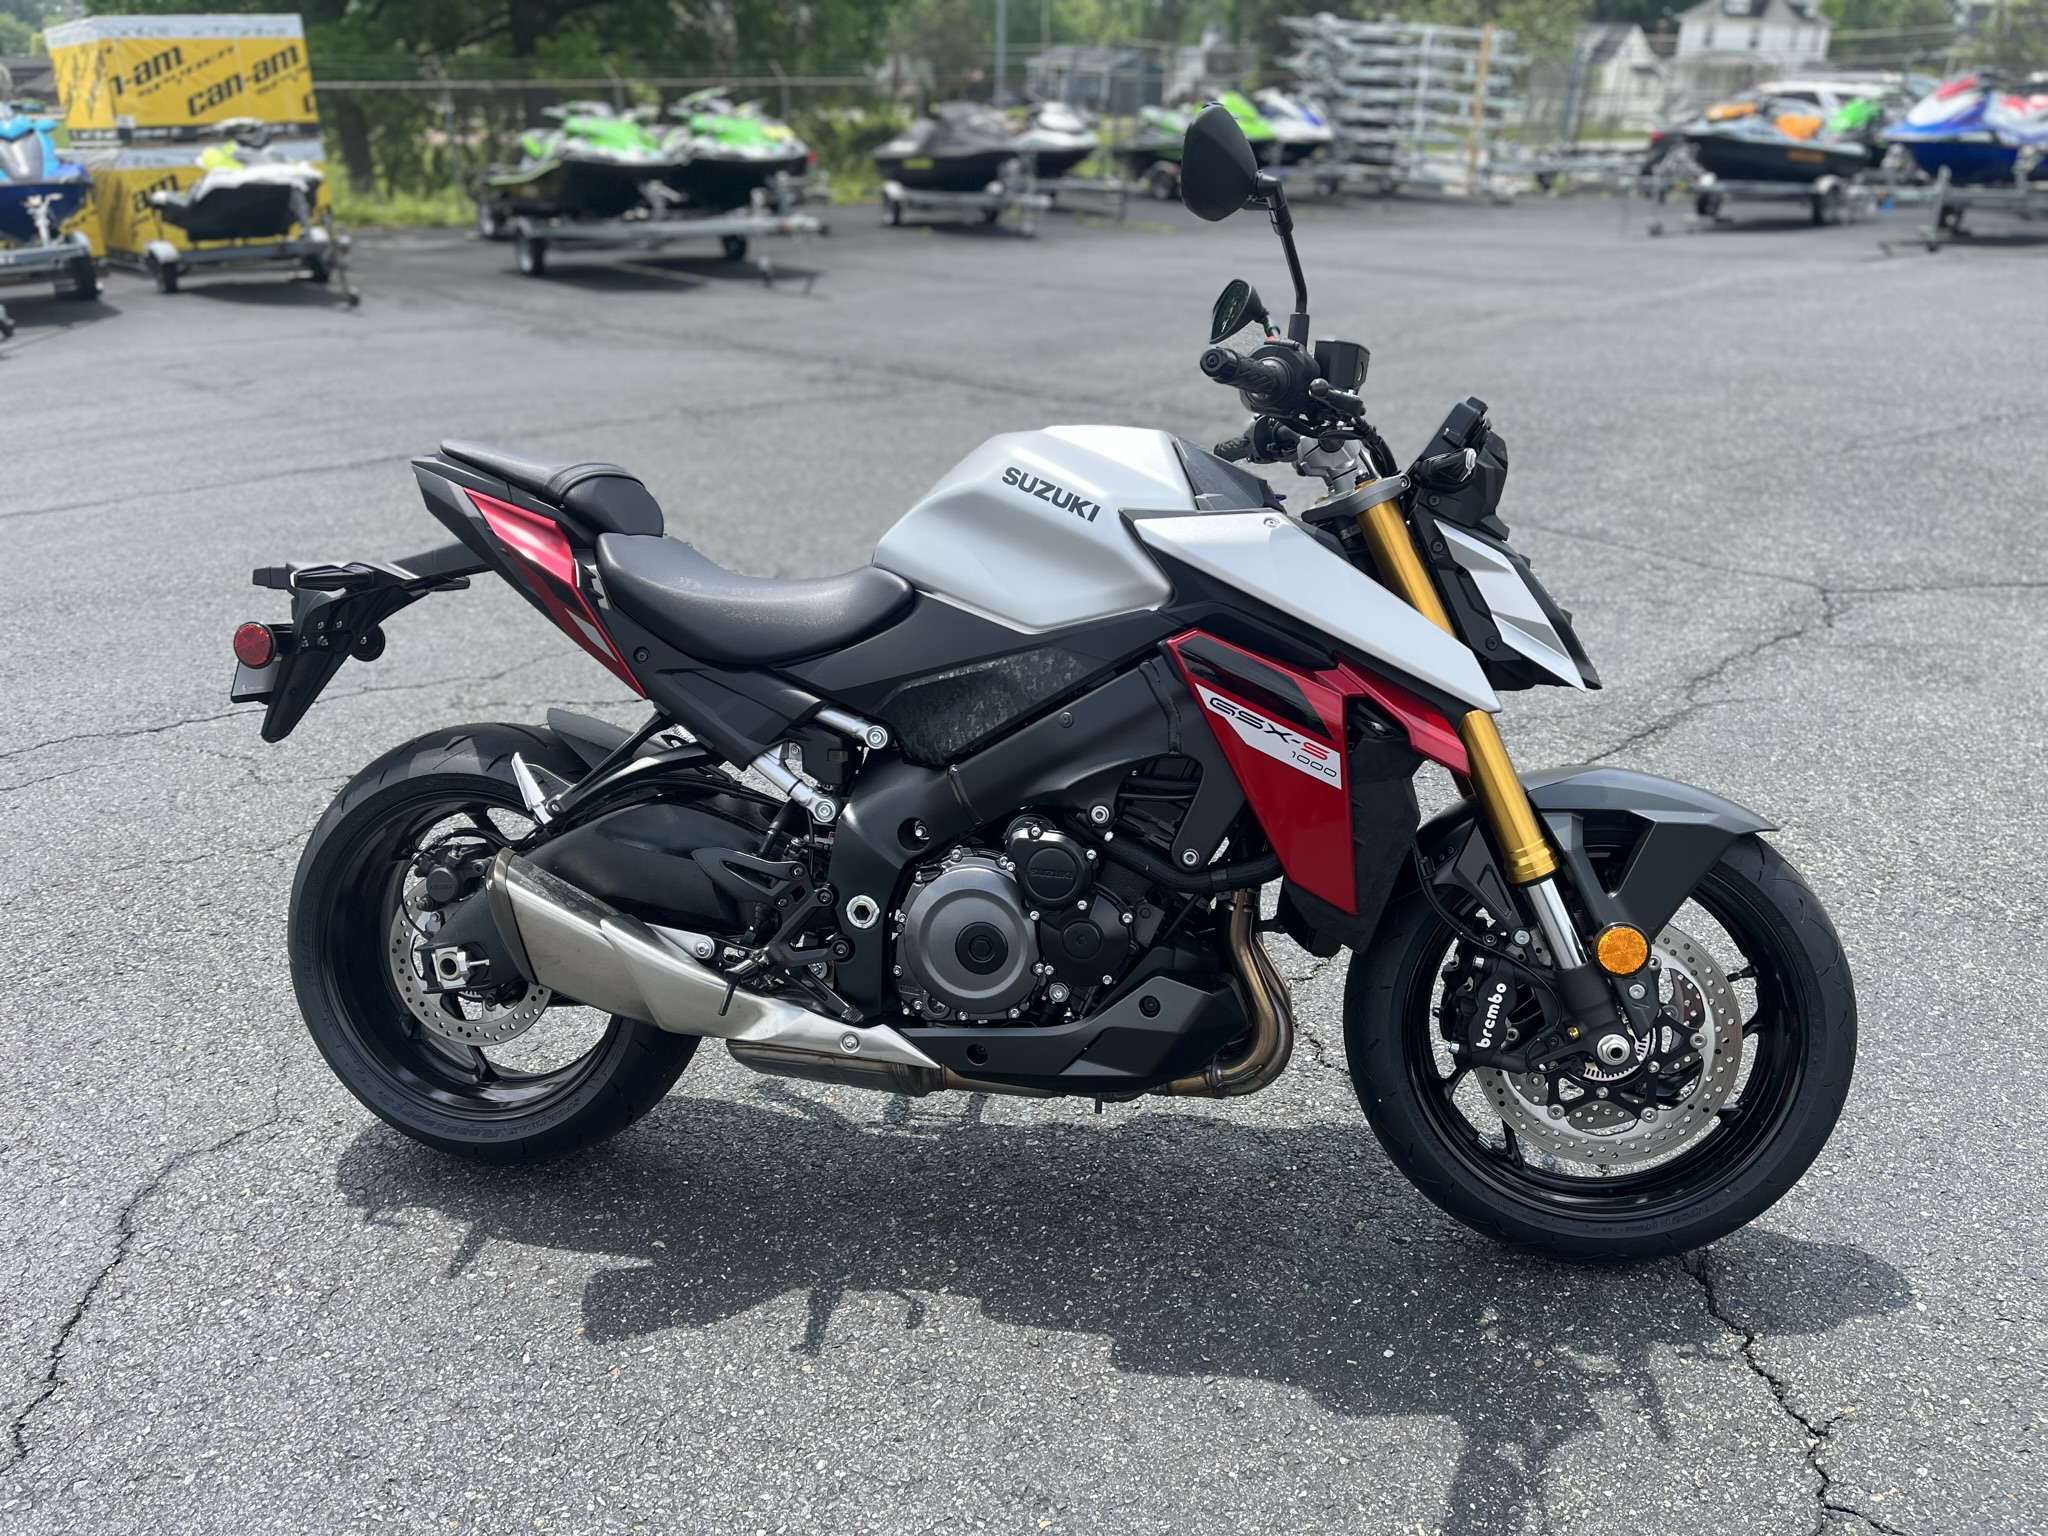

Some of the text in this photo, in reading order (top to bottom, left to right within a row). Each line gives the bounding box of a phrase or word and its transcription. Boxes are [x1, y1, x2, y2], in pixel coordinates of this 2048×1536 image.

[187, 44, 299, 117] can-am
[1002, 467, 1101, 522] SUZUKI
[1209, 697, 1330, 760] GSX-S
[1291, 751, 1337, 777] 1000
[1030, 868, 1074, 880] SUZUKI
[1476, 983, 1507, 1048] brembo
